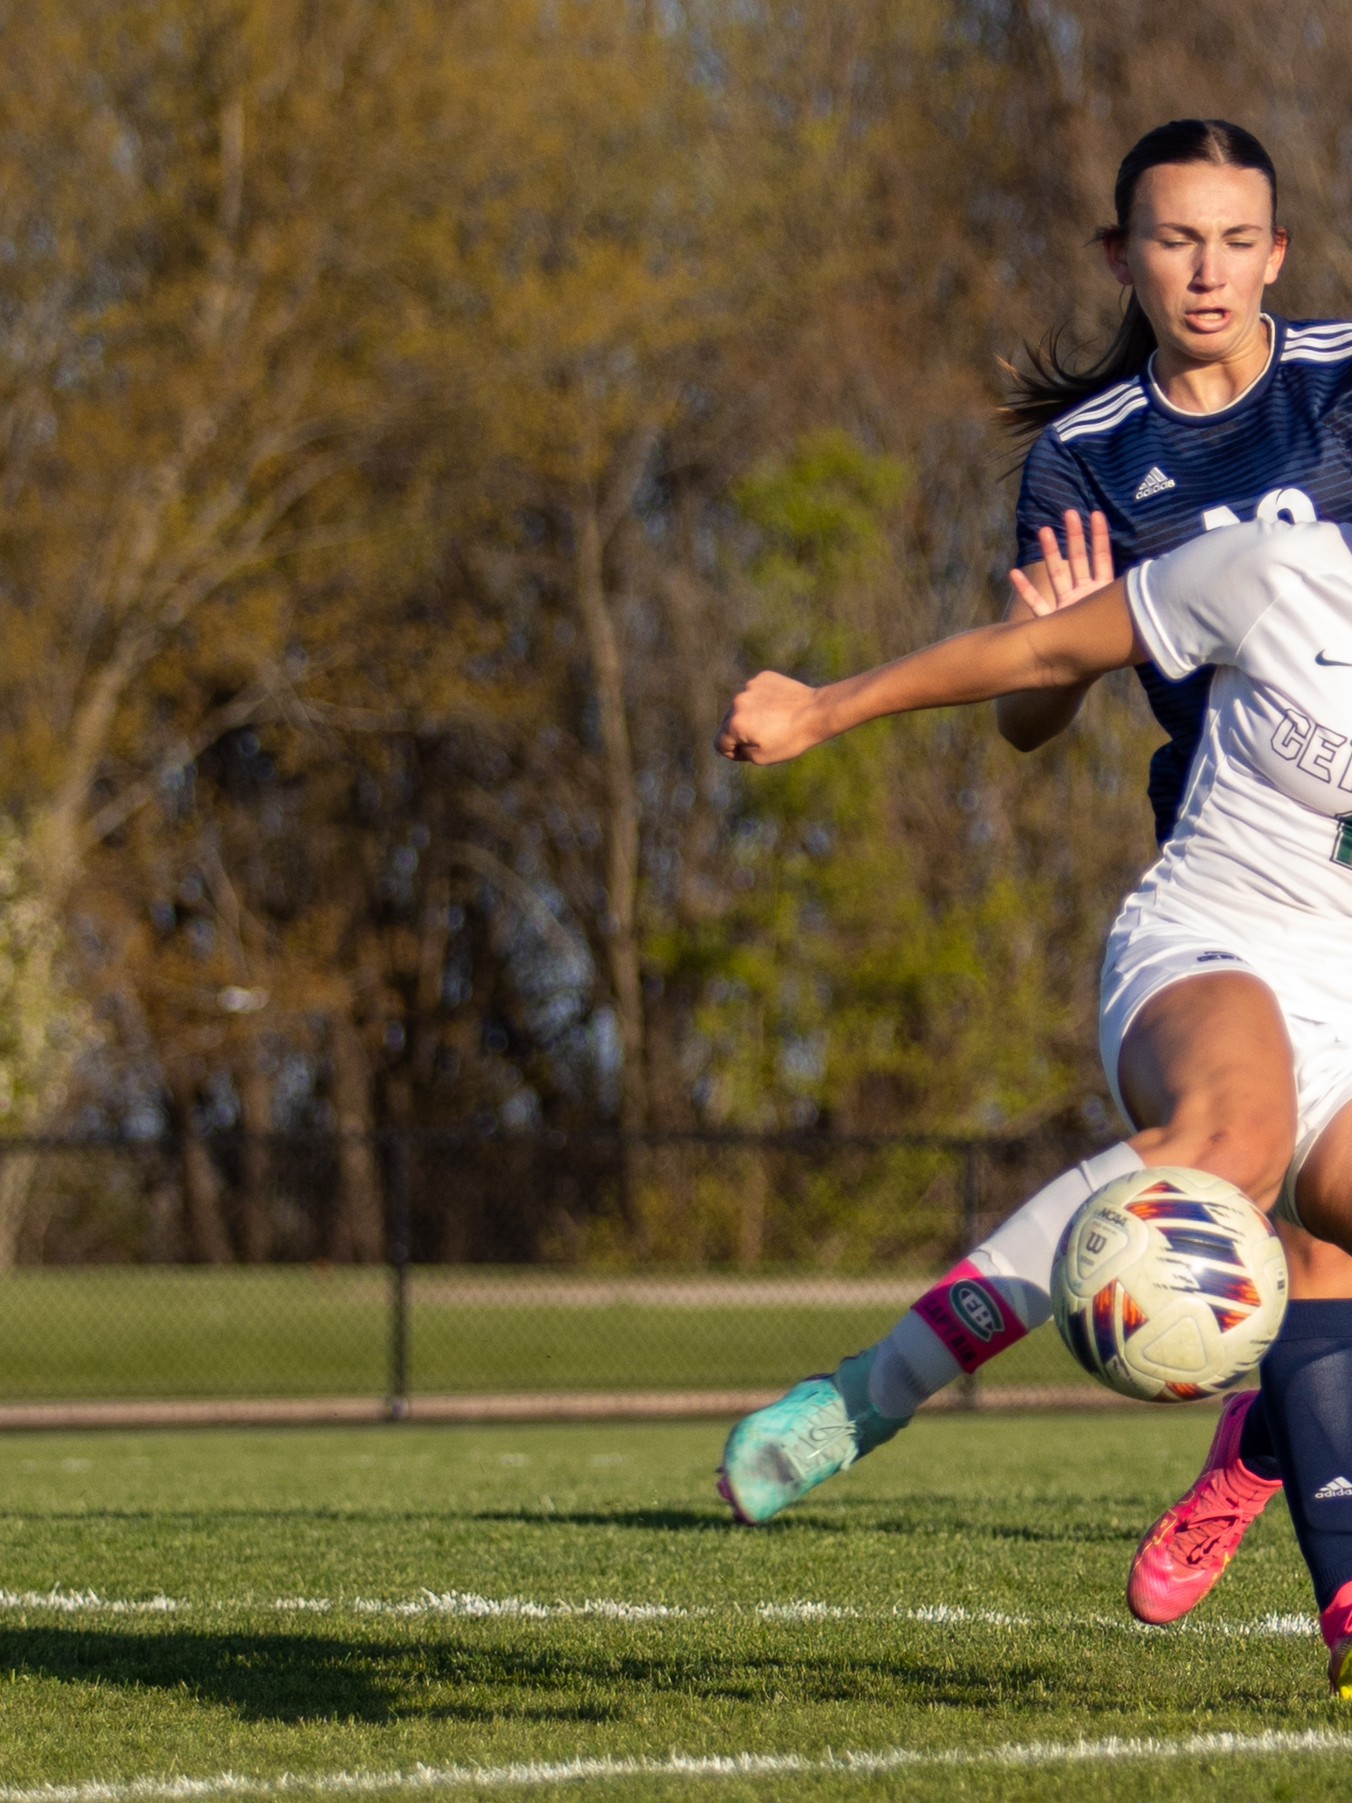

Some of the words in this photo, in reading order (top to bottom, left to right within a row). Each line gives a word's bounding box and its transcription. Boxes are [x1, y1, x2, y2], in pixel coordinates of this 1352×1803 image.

[1135, 479, 1176, 500] adidas
[1098, 1207, 1129, 1227] NCAA
[923, 1298, 977, 1363] CAPTAIN
